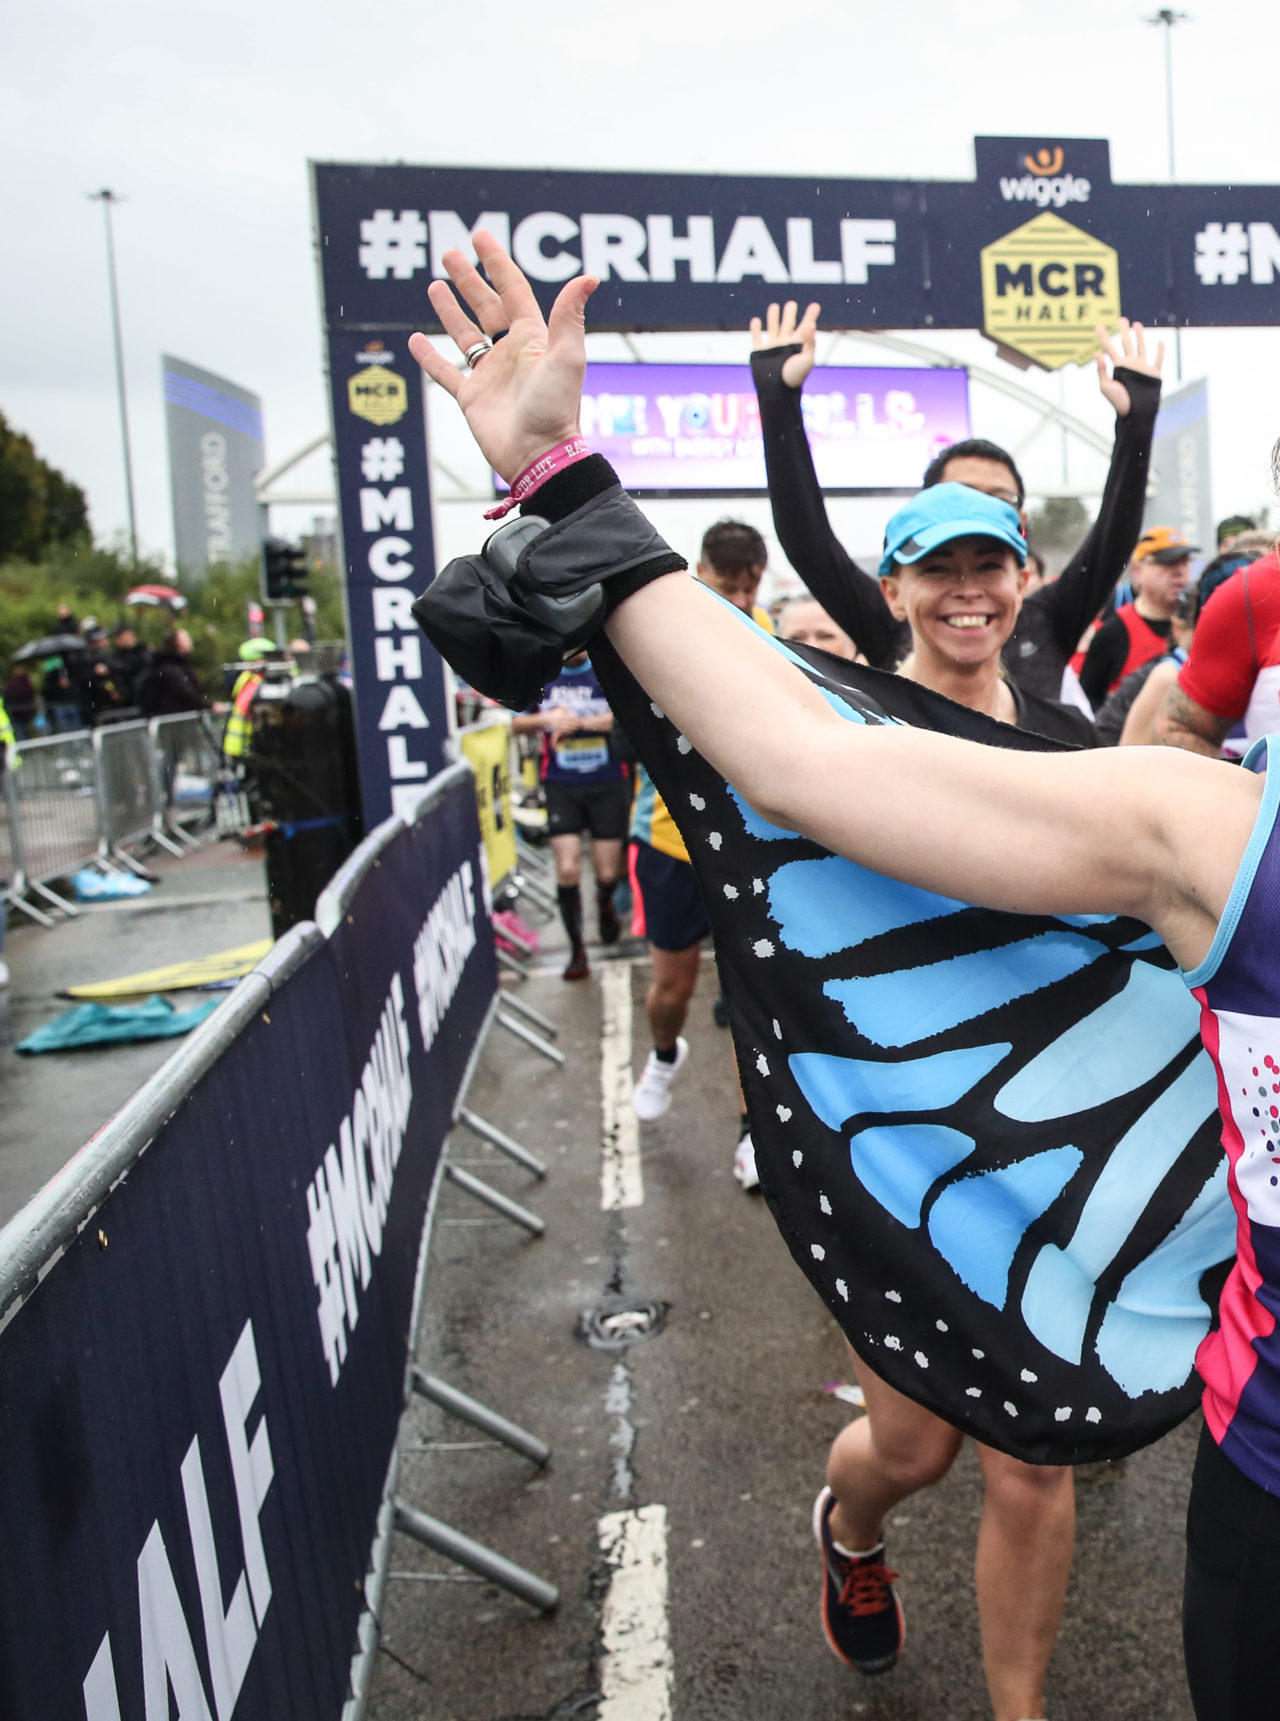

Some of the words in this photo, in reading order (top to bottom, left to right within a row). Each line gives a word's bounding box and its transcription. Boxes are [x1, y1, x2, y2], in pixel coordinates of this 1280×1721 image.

[1000, 173, 1091, 207] wiggle
[359, 208, 896, 285] #MCRHALF
[994, 262, 1106, 297] MCR
[1016, 303, 1090, 322] HALF
[530, 455, 557, 481] LIFE
[307, 972, 413, 1388] #MCRHALF
